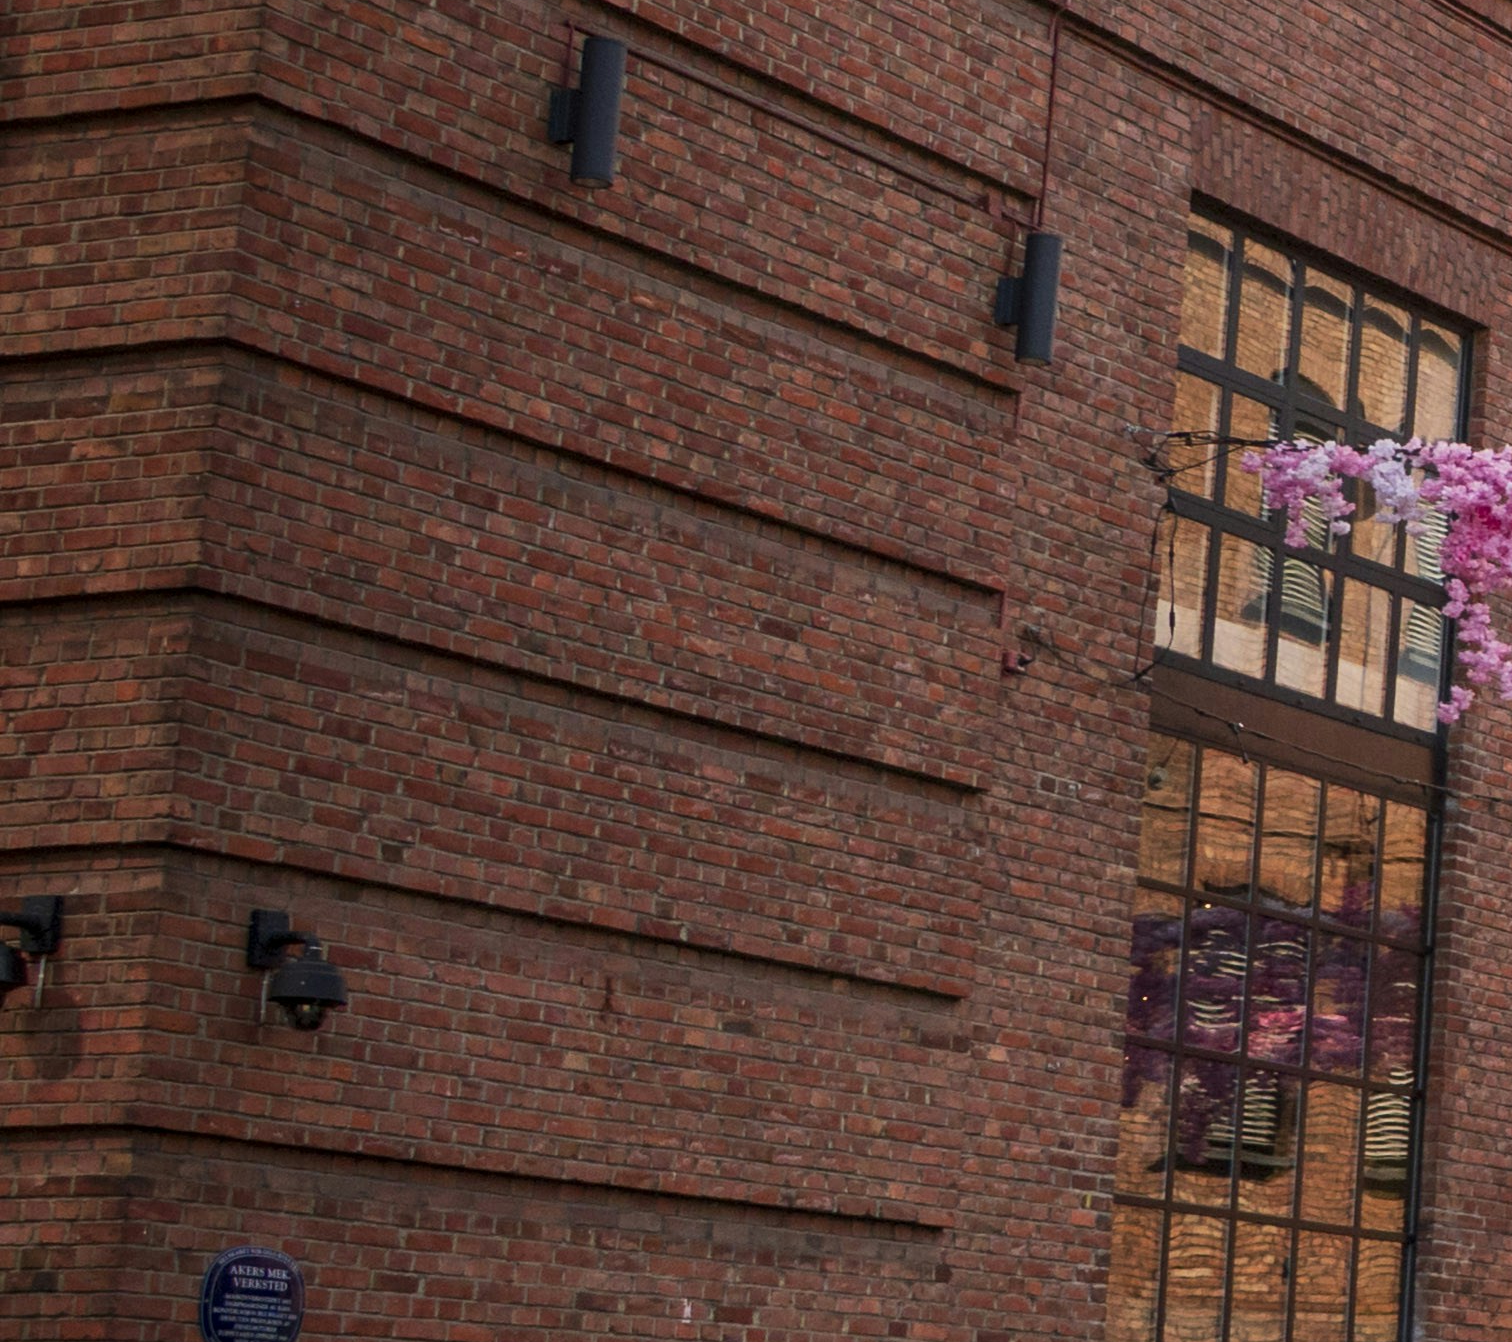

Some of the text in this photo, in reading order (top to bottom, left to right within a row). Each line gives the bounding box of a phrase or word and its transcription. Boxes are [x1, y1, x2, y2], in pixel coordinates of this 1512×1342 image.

[230, 1265, 291, 1279] AKERS MEK.
[233, 1277, 288, 1291] VERKSTED
